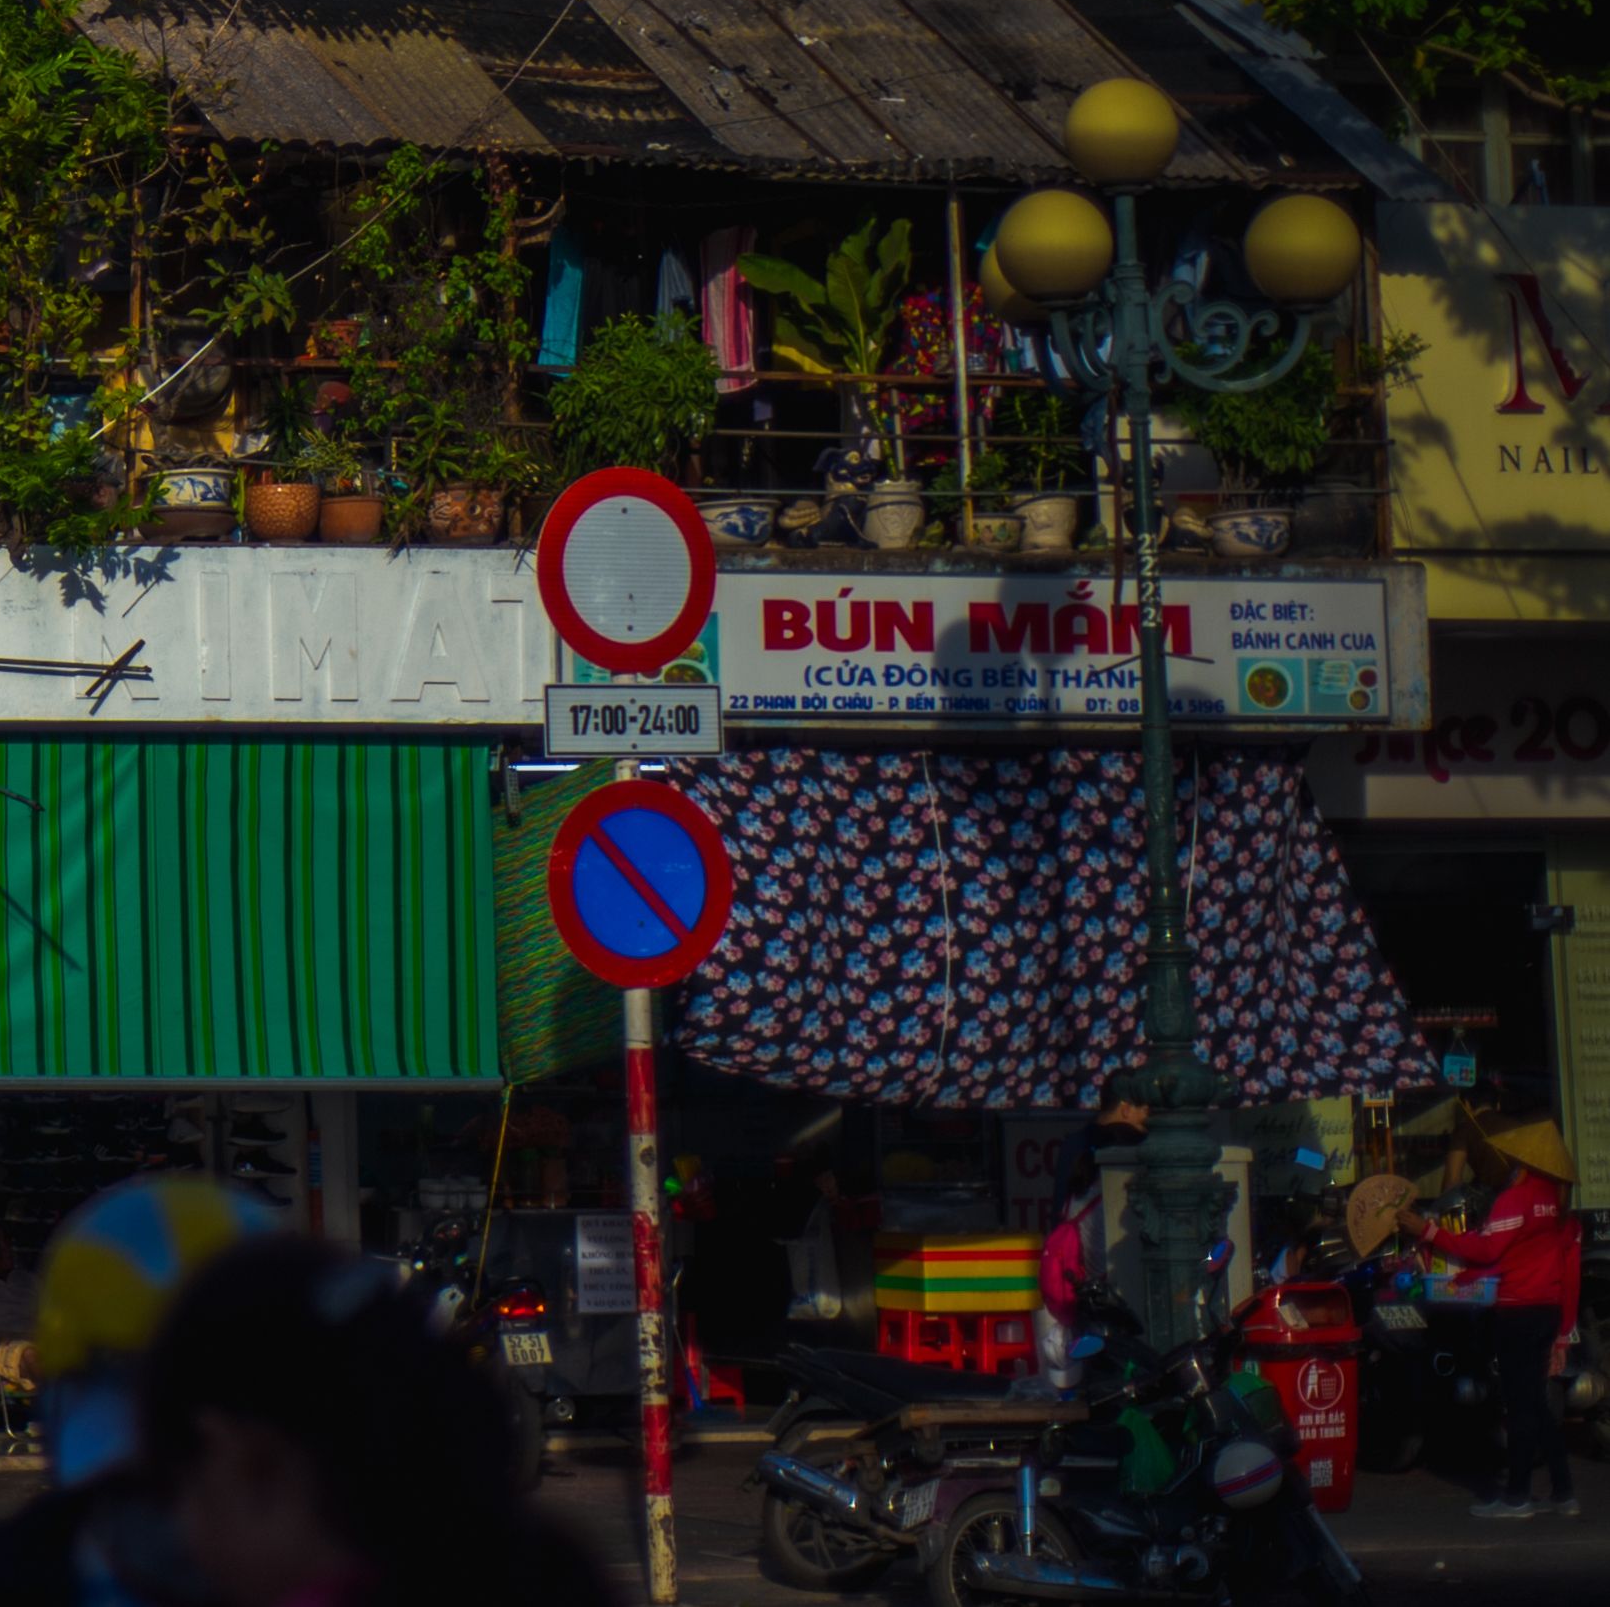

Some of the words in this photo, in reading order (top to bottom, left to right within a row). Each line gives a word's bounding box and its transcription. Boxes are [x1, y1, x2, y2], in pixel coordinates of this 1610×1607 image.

[763, 587, 933, 652] BÚN
[969, 580, 1192, 655] MẮM
[1230, 601, 1267, 623] ĐẶC
[1272, 600, 1316, 623] BIỆT:
[1232, 629, 1281, 651] BÁNH
[1286, 632, 1336, 651] CANH
[1341, 632, 1376, 651] CUA
[882, 661, 973, 689] ĐÔNG
[983, 661, 1037, 690] BẾN
[729, 695, 749, 710] 22
[754, 695, 796, 710] PHAN
[1189, 698, 1225, 714] 5196
[570, 705, 700, 736] 17:00-24:00
[512, 1348, 545, 1363] 6007
